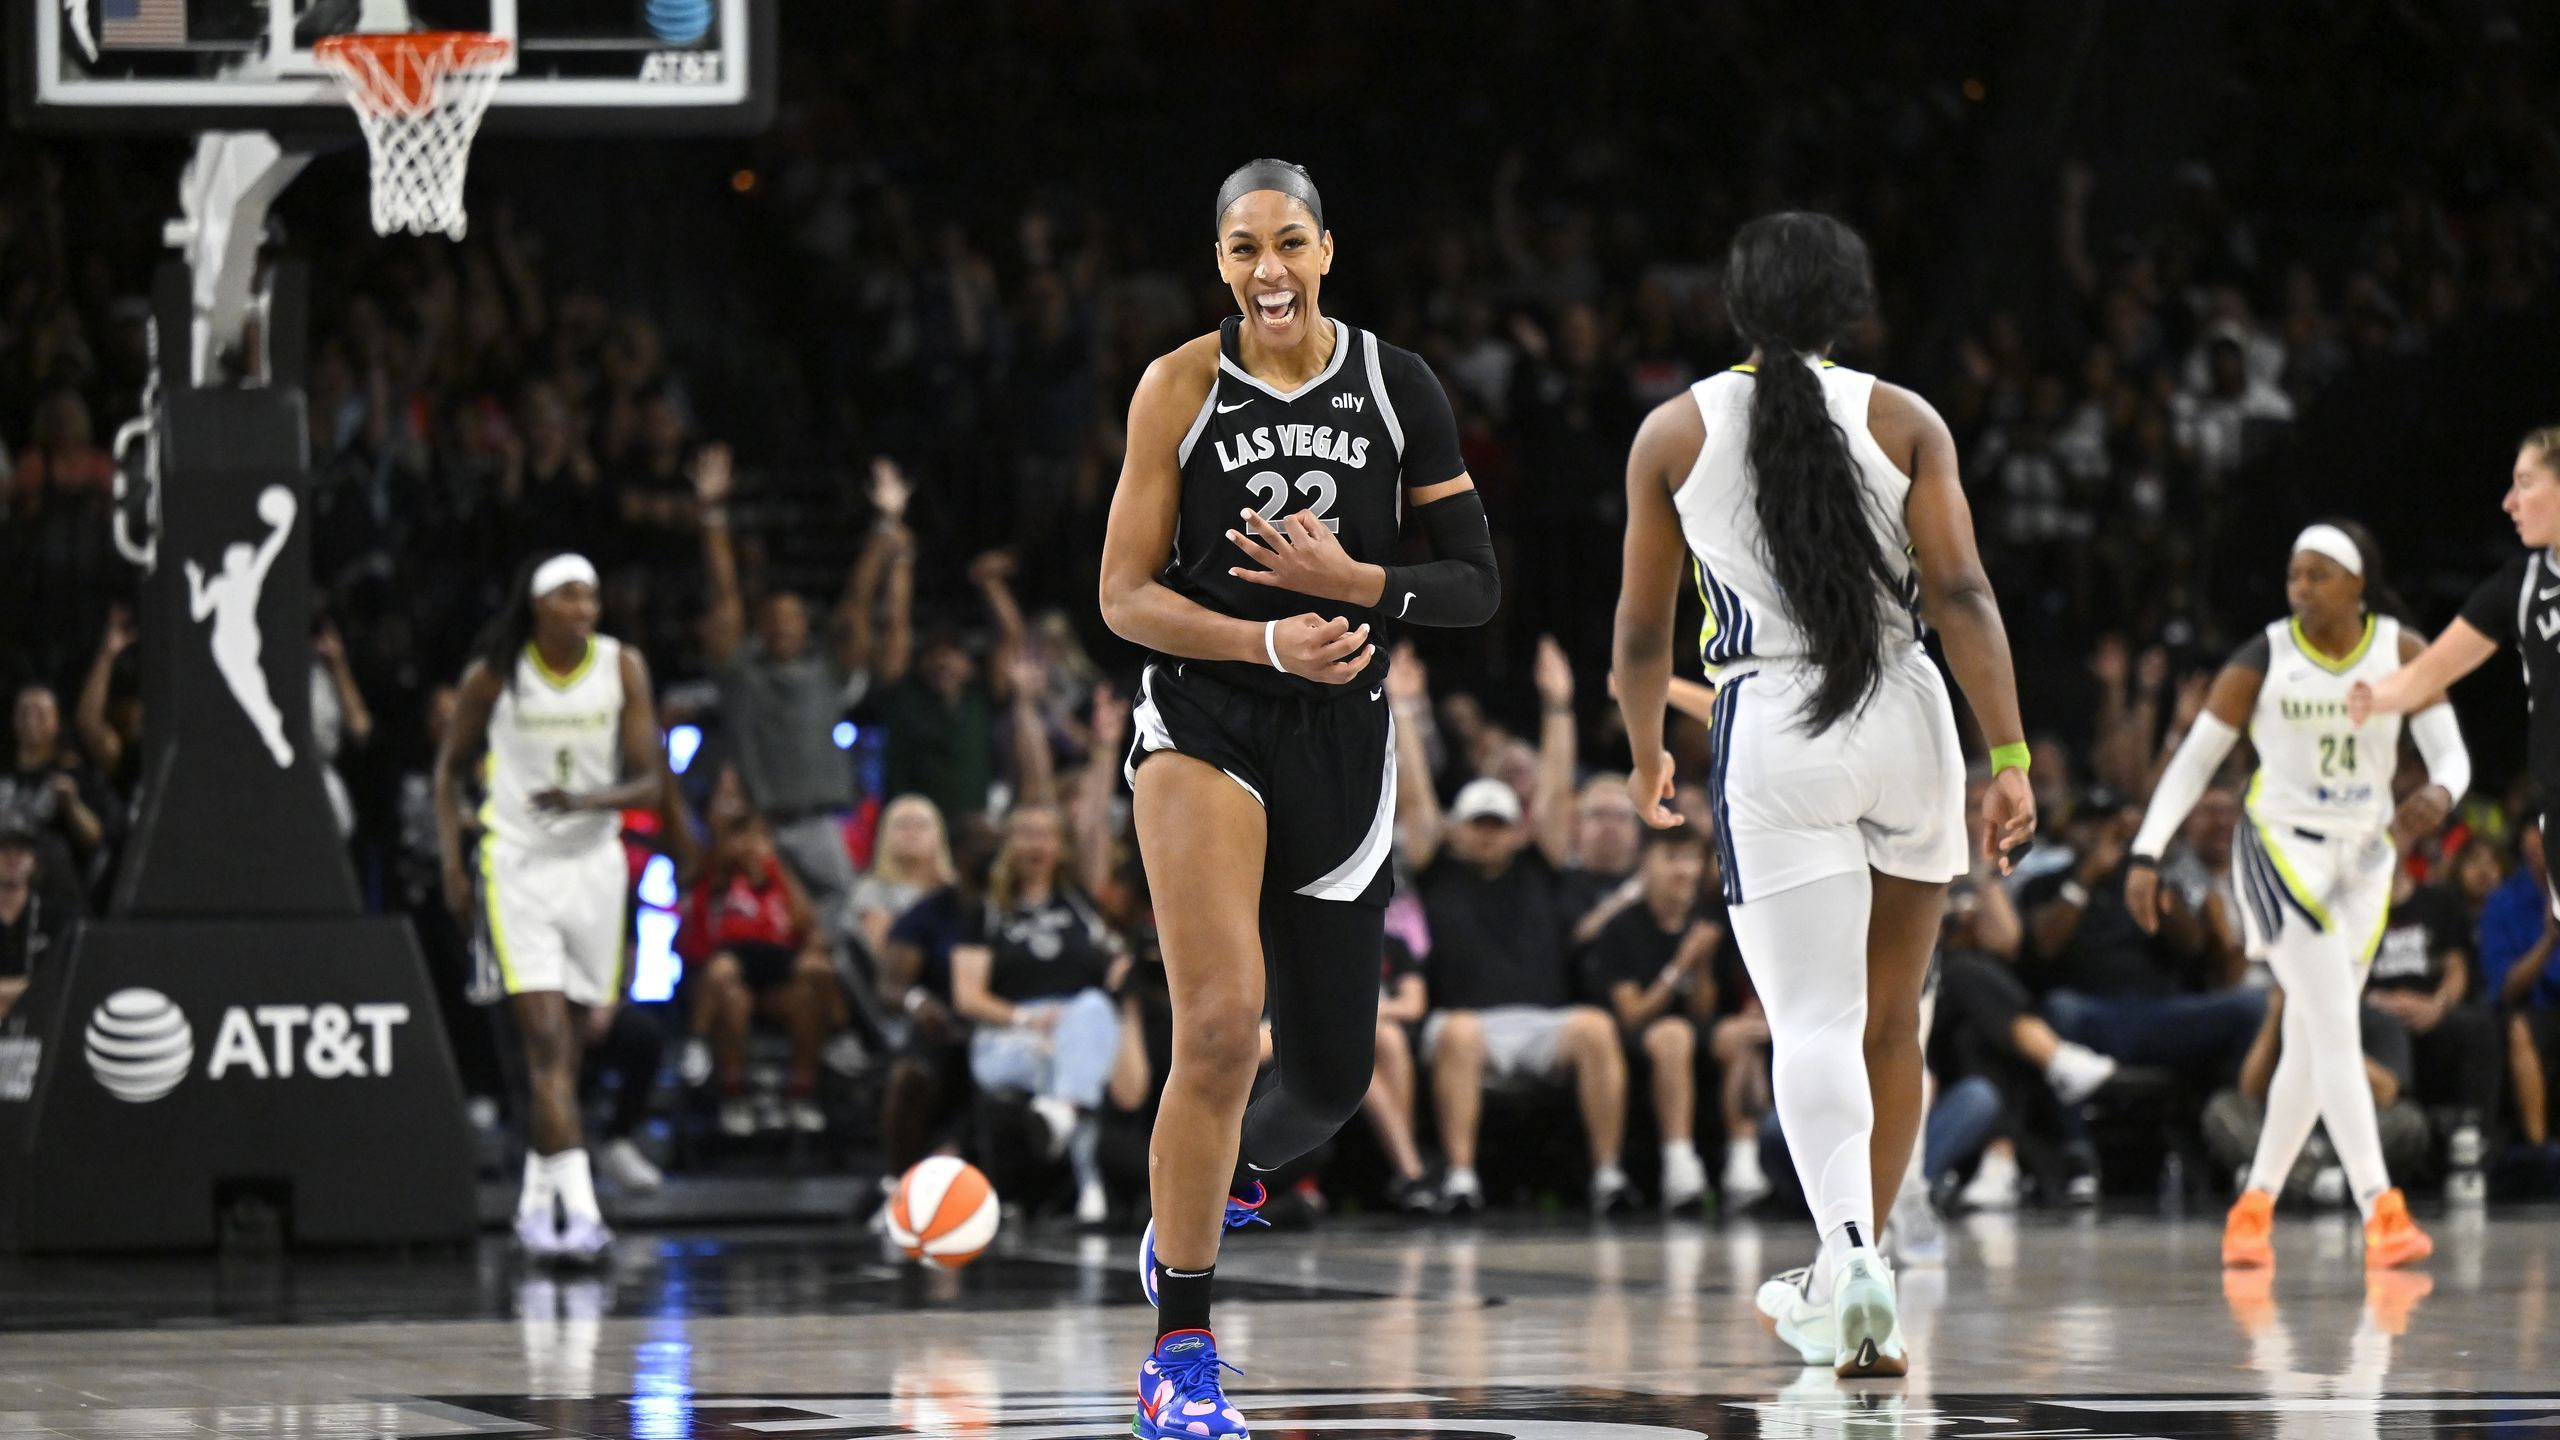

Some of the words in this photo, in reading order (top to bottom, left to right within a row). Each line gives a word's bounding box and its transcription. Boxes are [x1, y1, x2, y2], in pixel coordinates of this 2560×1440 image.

[638, 51, 721, 84] AT&T
[1331, 392, 1365, 413] ally
[1214, 426, 1275, 473] LAS
[1275, 423, 1371, 469] VEGAS
[1245, 469, 1340, 535] 22
[2319, 733, 2356, 777] 24
[207, 1003, 410, 1080] AT&T
